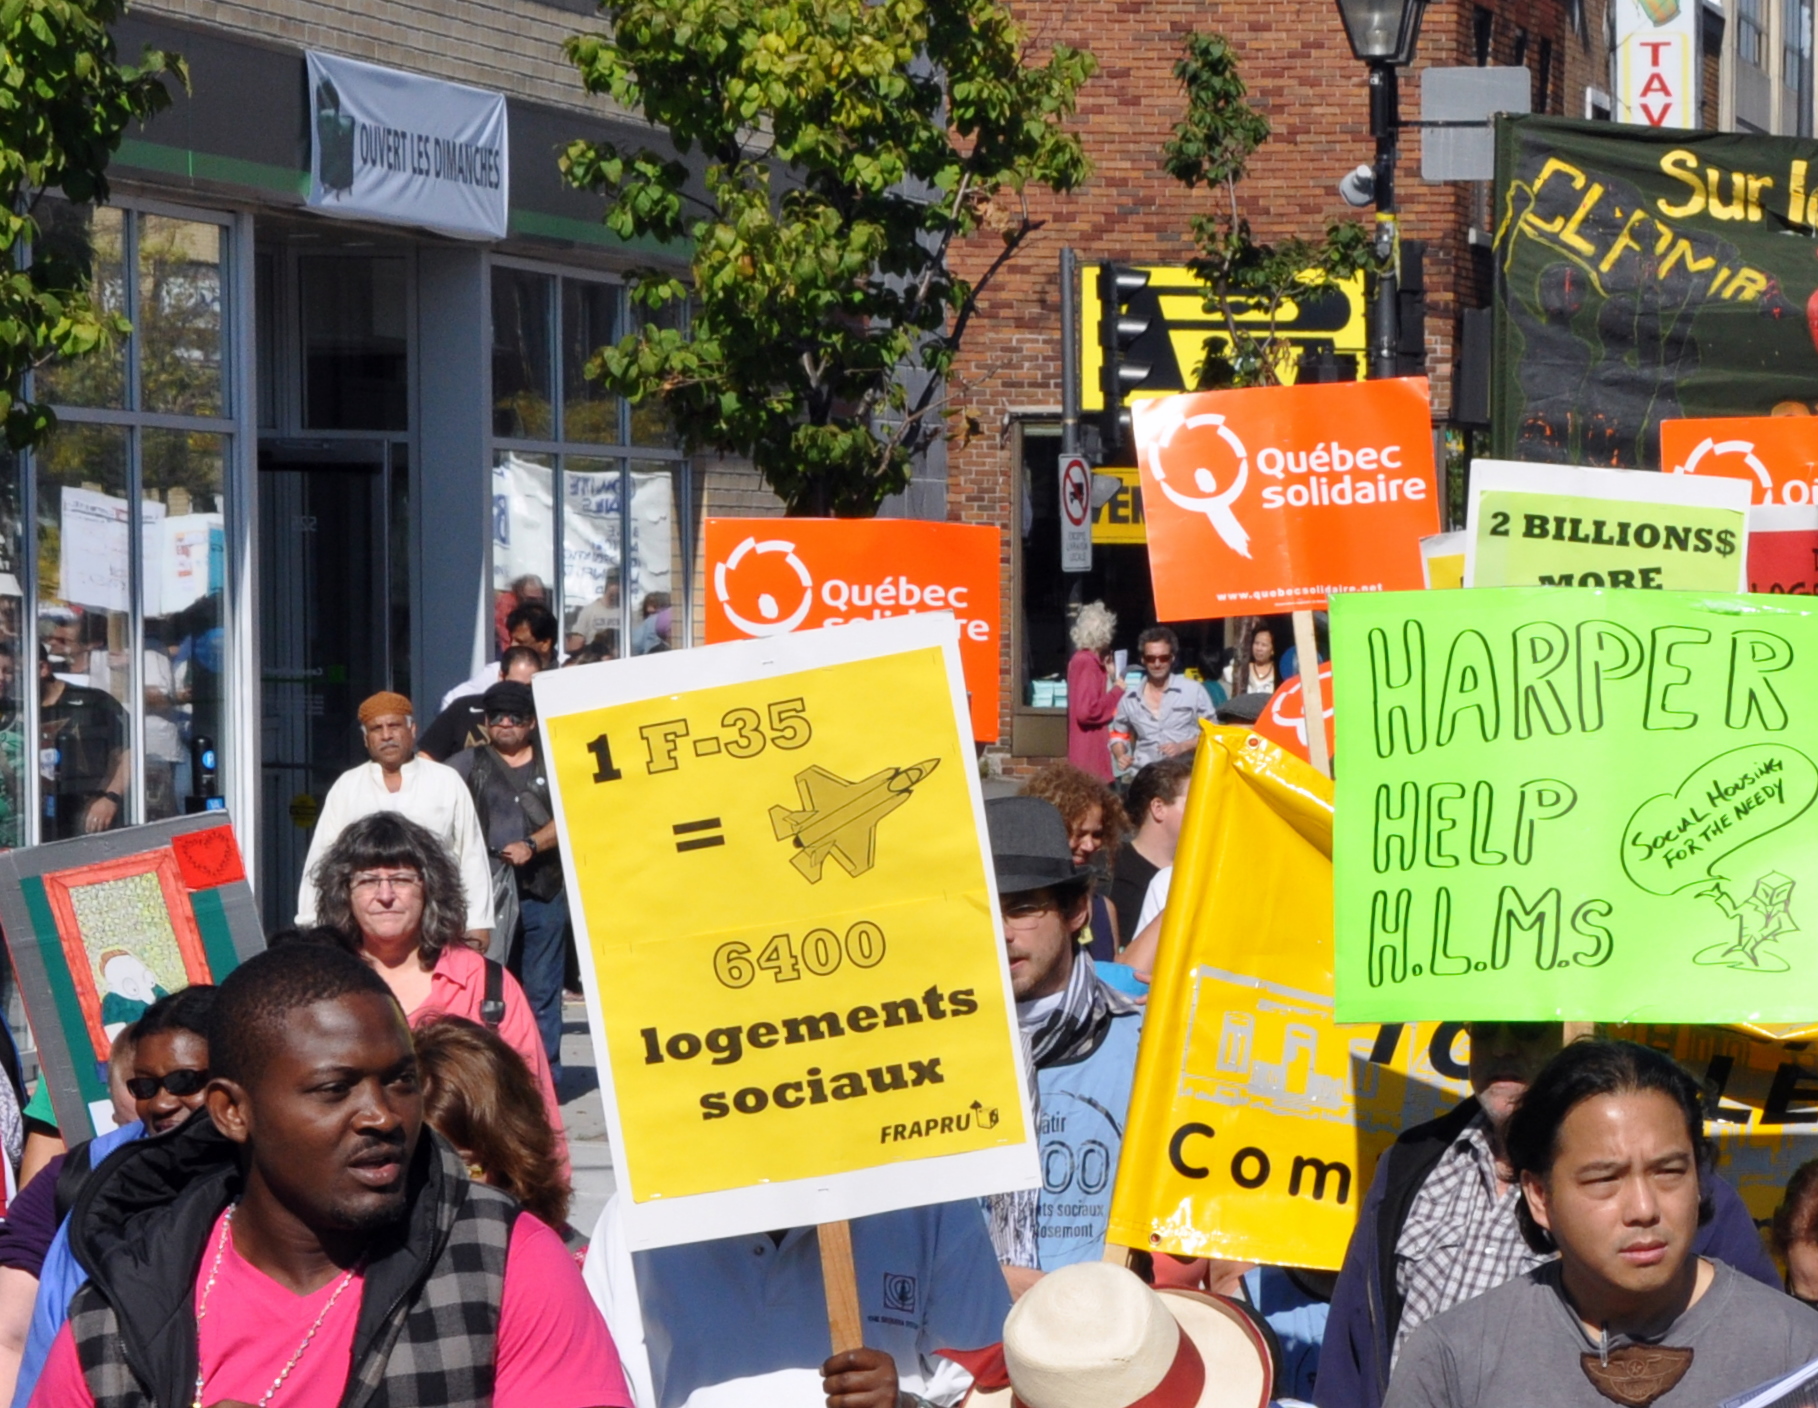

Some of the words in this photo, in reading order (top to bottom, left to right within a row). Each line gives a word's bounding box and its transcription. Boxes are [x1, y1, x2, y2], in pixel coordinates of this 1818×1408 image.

[360, 122, 407, 172] OUVERT
[411, 132, 430, 177] LES
[434, 137, 500, 190] DIMANCHES
[1657, 149, 1773, 222] Sur
[1257, 442, 1402, 480] Québec
[1262, 474, 1427, 509] solidaire
[1489, 511, 1511, 537] 2
[1523, 513, 1737, 558] BILLIONS$
[821, 576, 968, 612] Québec
[1216, 583, 1383, 602] www.quebecsolidaire.net
[1368, 619, 1794, 758] HARPER
[586, 733, 622, 784] 1
[638, 696, 813, 776] F-35
[1373, 778, 1578, 873] HELP
[1662, 838, 1704, 870] FOR
[1700, 814, 1733, 843] THE
[1733, 778, 1786, 821] NEEDY
[713, 920, 887, 990] 6400
[640, 984, 979, 1065] logements
[699, 1056, 945, 1121] sociaux
[880, 1114, 972, 1146] FRAPRU
[1056, 1200, 1104, 1218] sociaux
